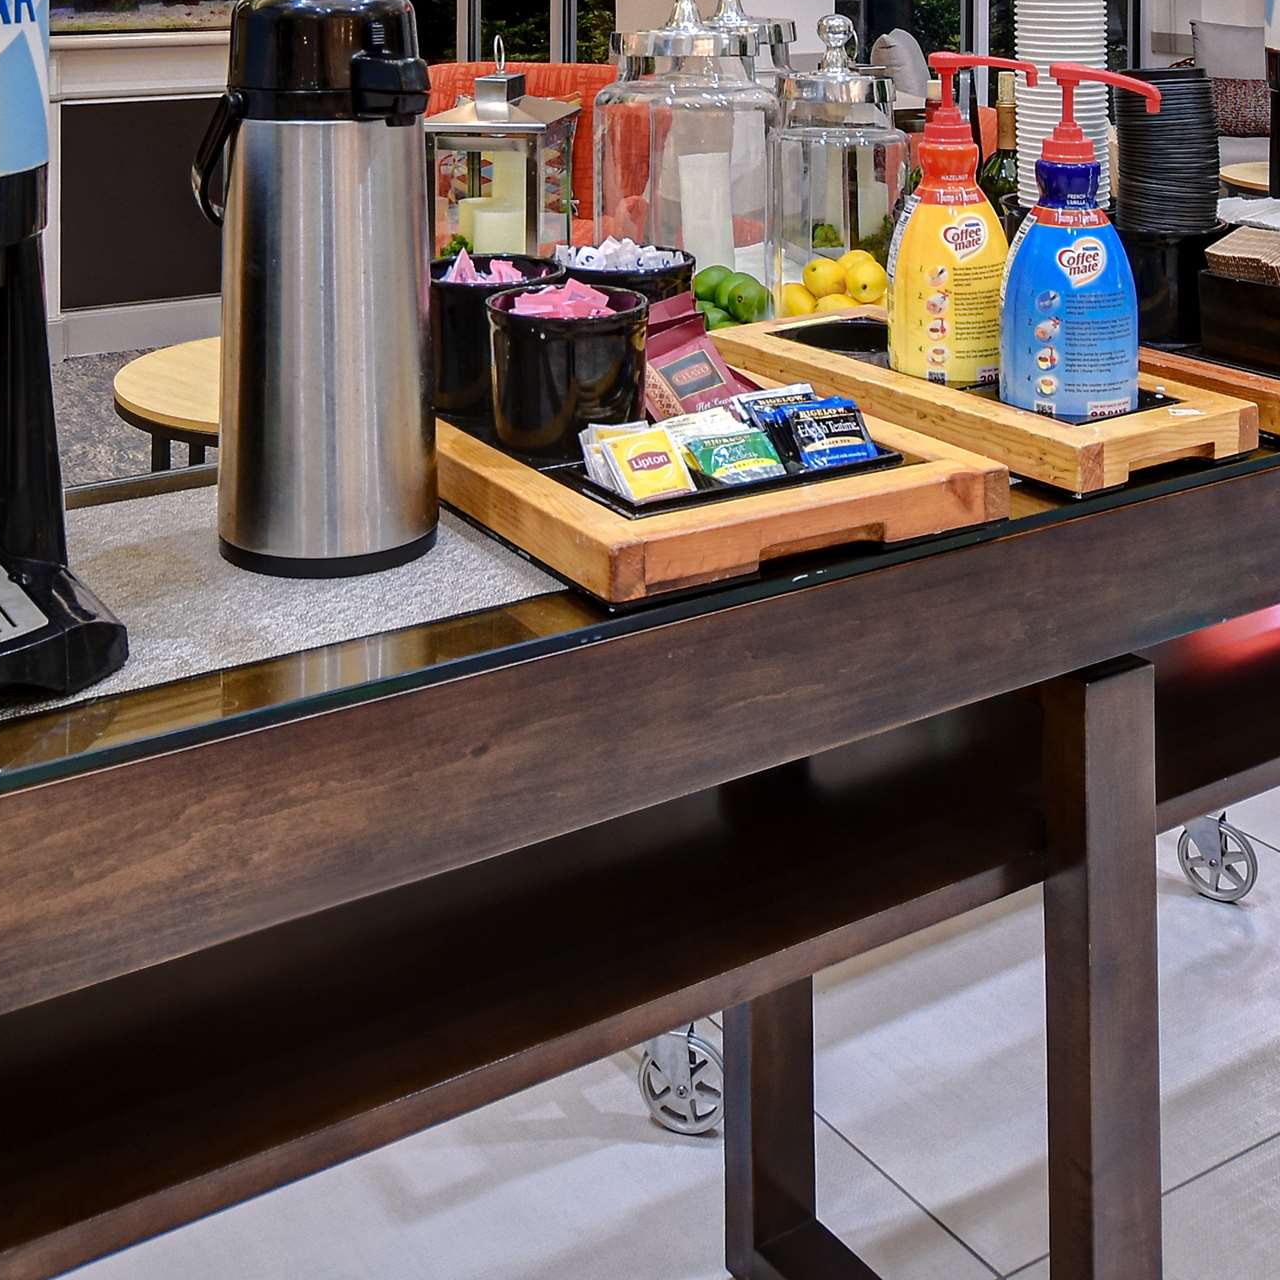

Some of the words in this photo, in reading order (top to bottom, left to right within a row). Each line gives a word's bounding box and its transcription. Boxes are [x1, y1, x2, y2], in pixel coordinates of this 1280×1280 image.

[943, 226, 982, 244] Coffee
[954, 237, 982, 252] mate
[1058, 249, 1100, 268] Coffee
[1068, 262, 1099, 276] mate
[695, 401, 712, 412] Hot
[757, 394, 806, 406] BIGELOW
[799, 407, 847, 419] BIGELOW
[631, 454, 668, 470] Lipton
